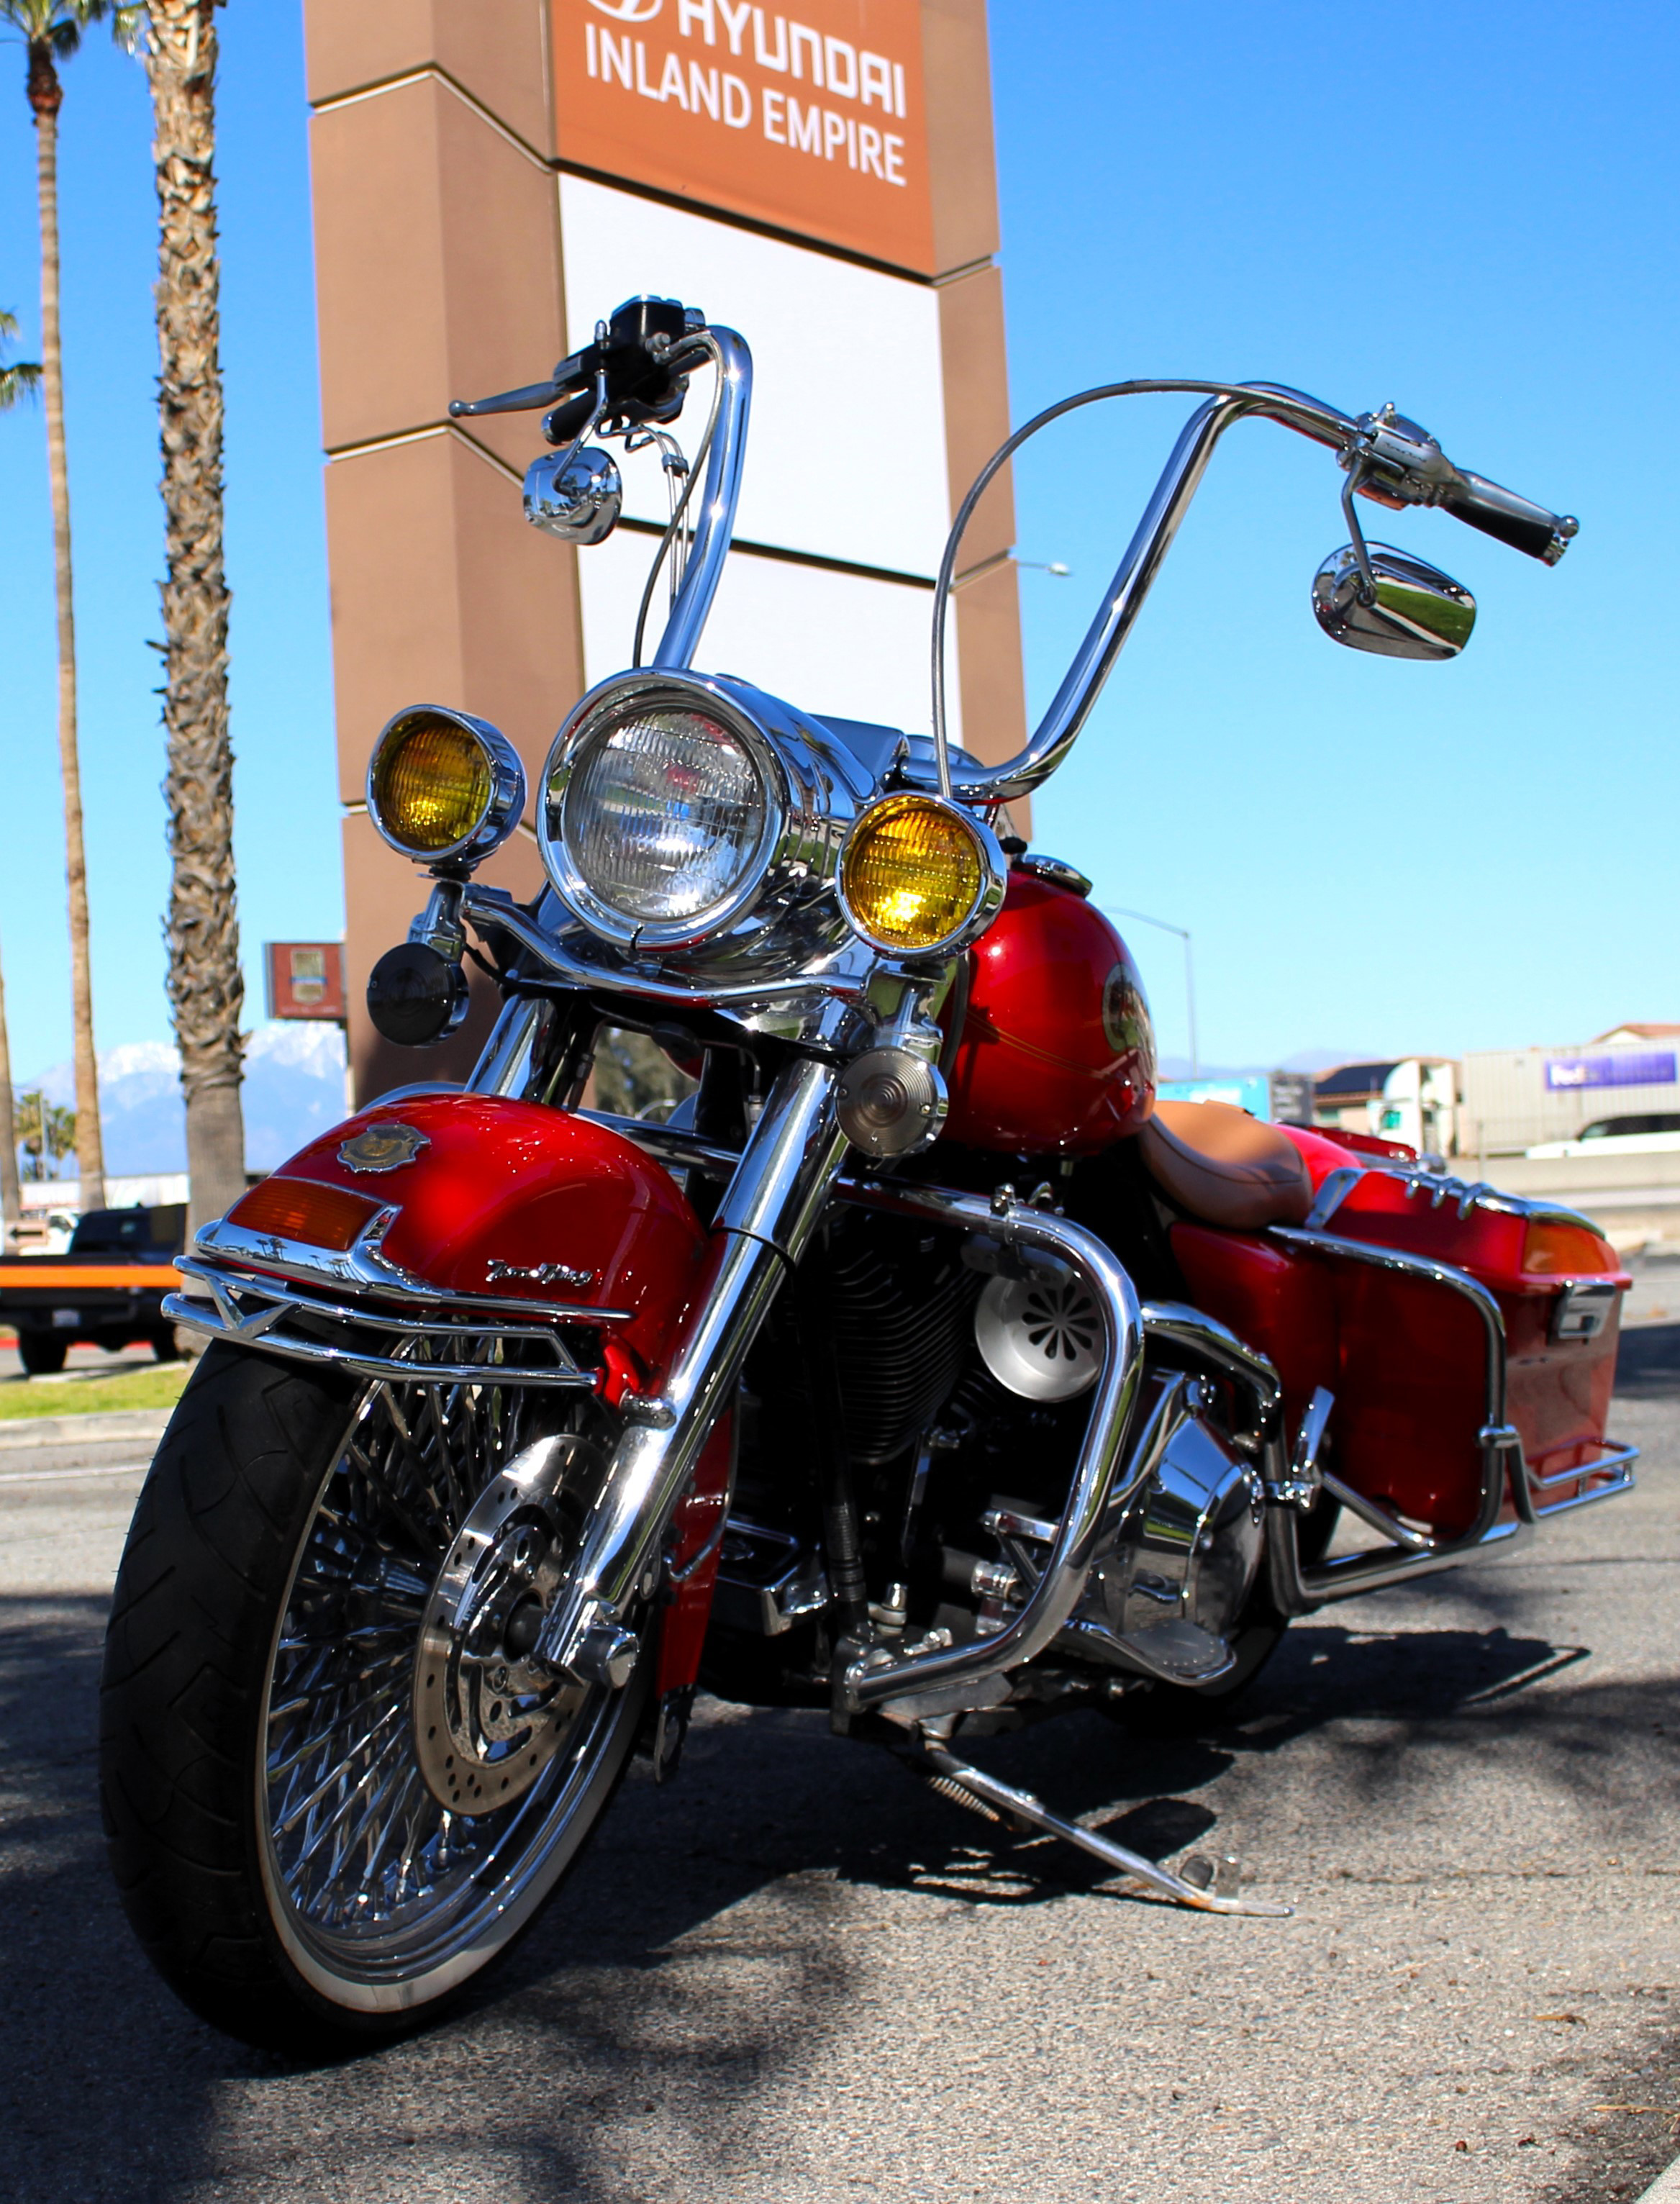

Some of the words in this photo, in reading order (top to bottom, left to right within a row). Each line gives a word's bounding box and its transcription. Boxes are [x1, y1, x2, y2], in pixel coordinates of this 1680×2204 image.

[585, 22, 753, 129] INLAND
[763, 88, 907, 188] EMPIRE
[678, 0, 907, 119] HYUNDAI
